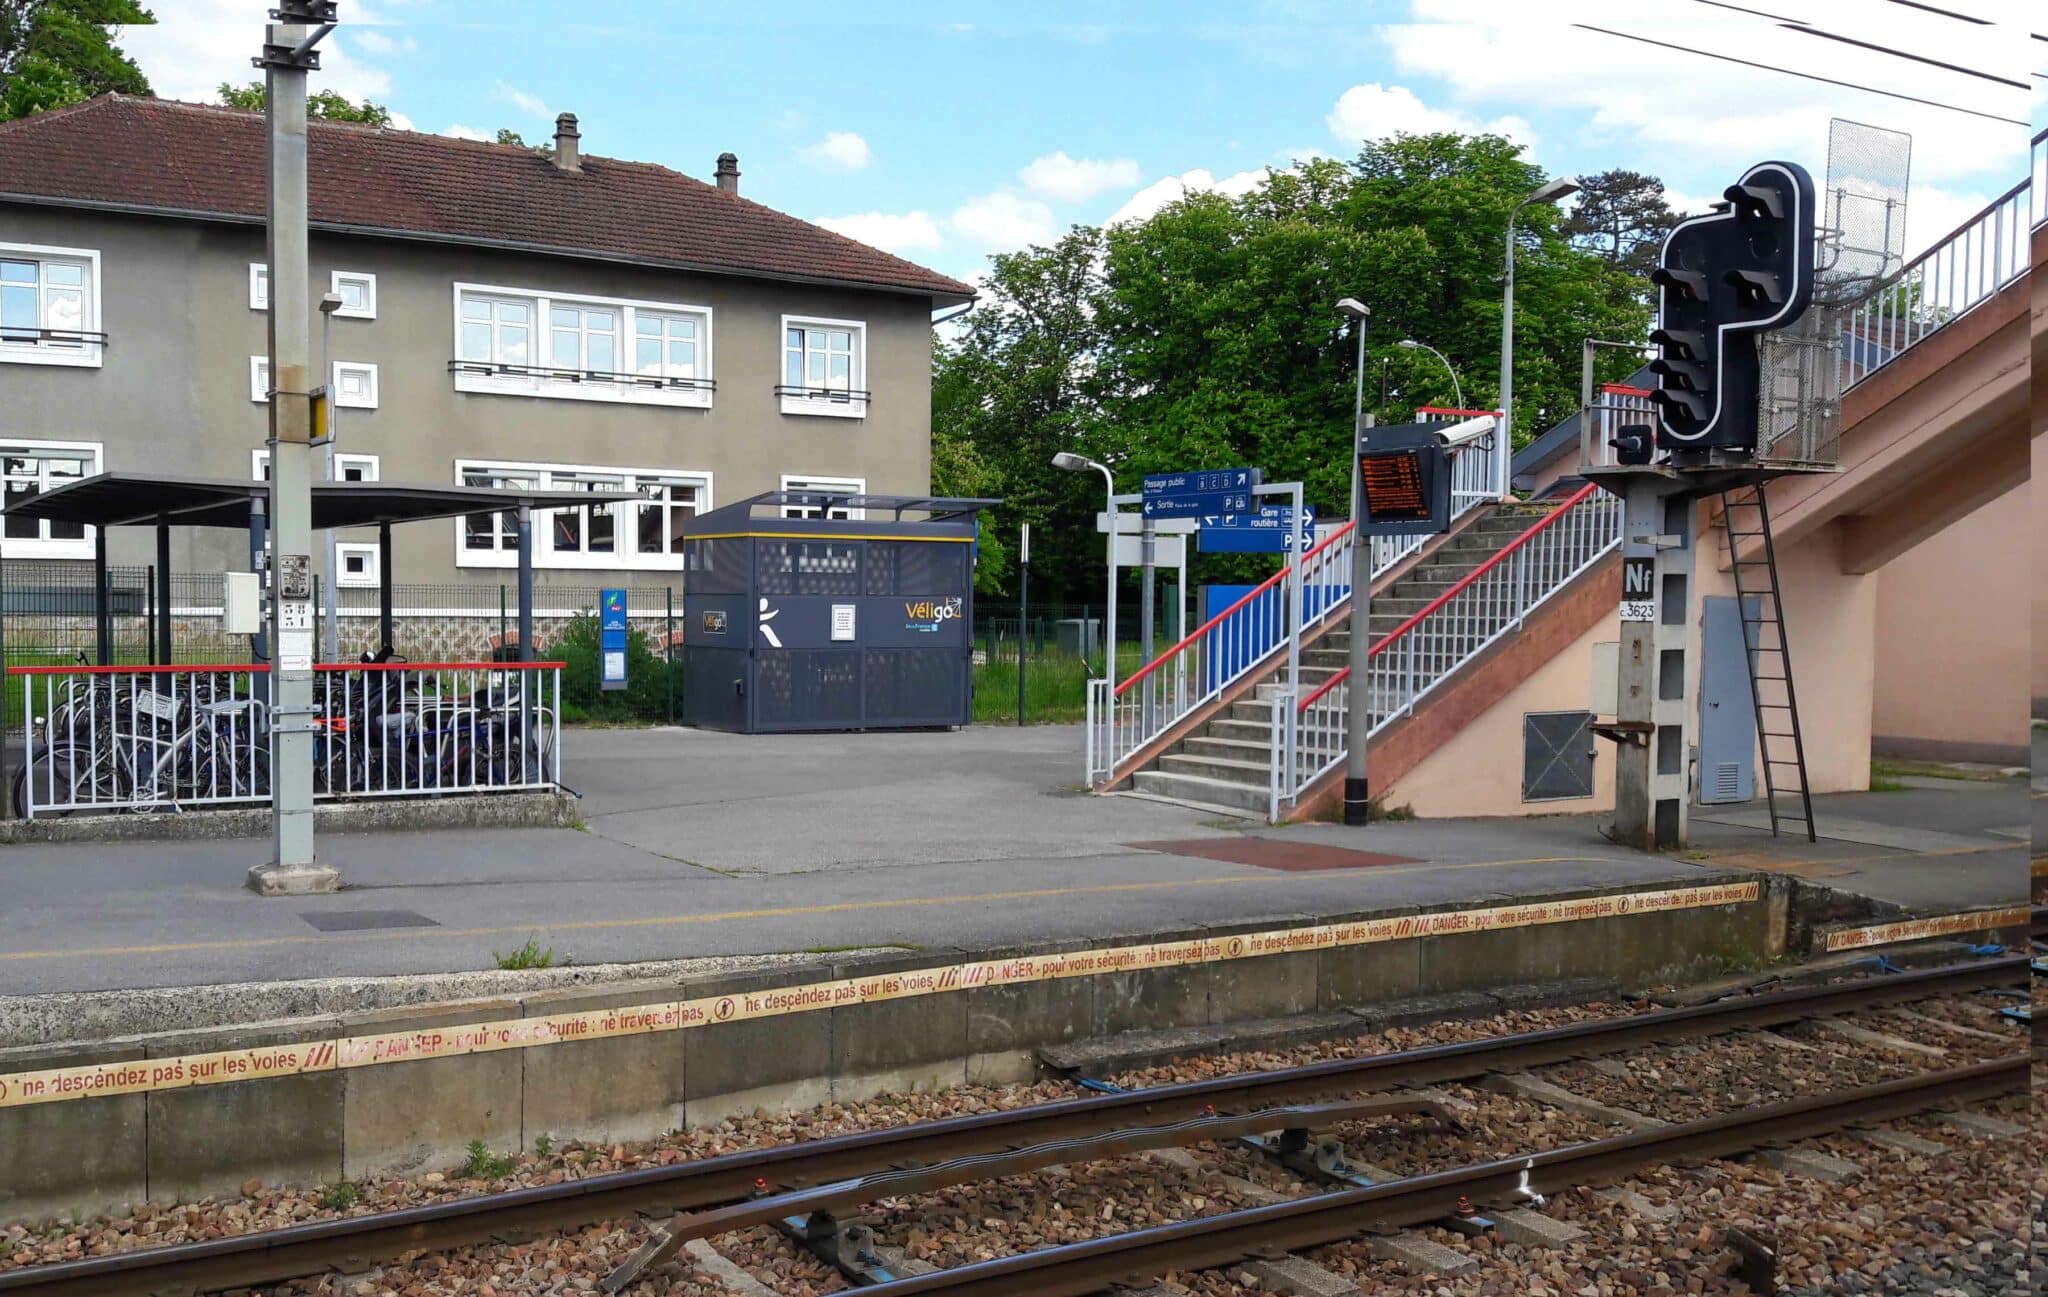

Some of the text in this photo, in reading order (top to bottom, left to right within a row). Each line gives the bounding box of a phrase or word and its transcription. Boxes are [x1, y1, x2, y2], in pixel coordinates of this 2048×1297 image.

[1143, 477, 1185, 489] Passage public
[1157, 500, 1174, 509] Sortie
[1225, 498, 1232, 508] P
[1261, 508, 1278, 517] Gare
[1250, 519, 1279, 528] routière
[1284, 535, 1293, 548] P
[1625, 563, 1652, 593] Nf
[905, 601, 954, 624] Véligo
[1432, 914, 1469, 931] DANGER
[1553, 905, 1563, 917] ne
[1565, 903, 1599, 917] traversez
[1600, 902, 1612, 915] pas
[1634, 898, 1645, 909] ne
[1685, 891, 1698, 906] pas
[1700, 891, 1712, 901] sur
[1712, 888, 1723, 900] les
[1725, 886, 1743, 900] voies
[1841, 931, 1868, 946] DANGER
[987, 962, 1033, 981] DNGER
[1042, 960, 1066, 977] pour
[1069, 956, 1094, 971] votre
[1145, 951, 1156, 962] ne
[1159, 946, 1201, 962] traversez
[1204, 944, 1220, 960] pas
[1251, 939, 1262, 951] ne
[1265, 933, 1315, 949] descendez
[1335, 929, 1350, 941] sur
[1352, 926, 1366, 939] les
[1369, 923, 1392, 937] voies
[600, 1017, 616, 1032] ne
[682, 1006, 704, 1025] pas
[745, 999, 762, 1012] ne
[765, 987, 831, 1010] descendez
[834, 986, 856, 1005] pas
[860, 982, 879, 997] sur
[882, 978, 900, 994] les
[902, 973, 933, 990] voies
[23, 1050, 297, 1097] ne descendez pas sur les voies
